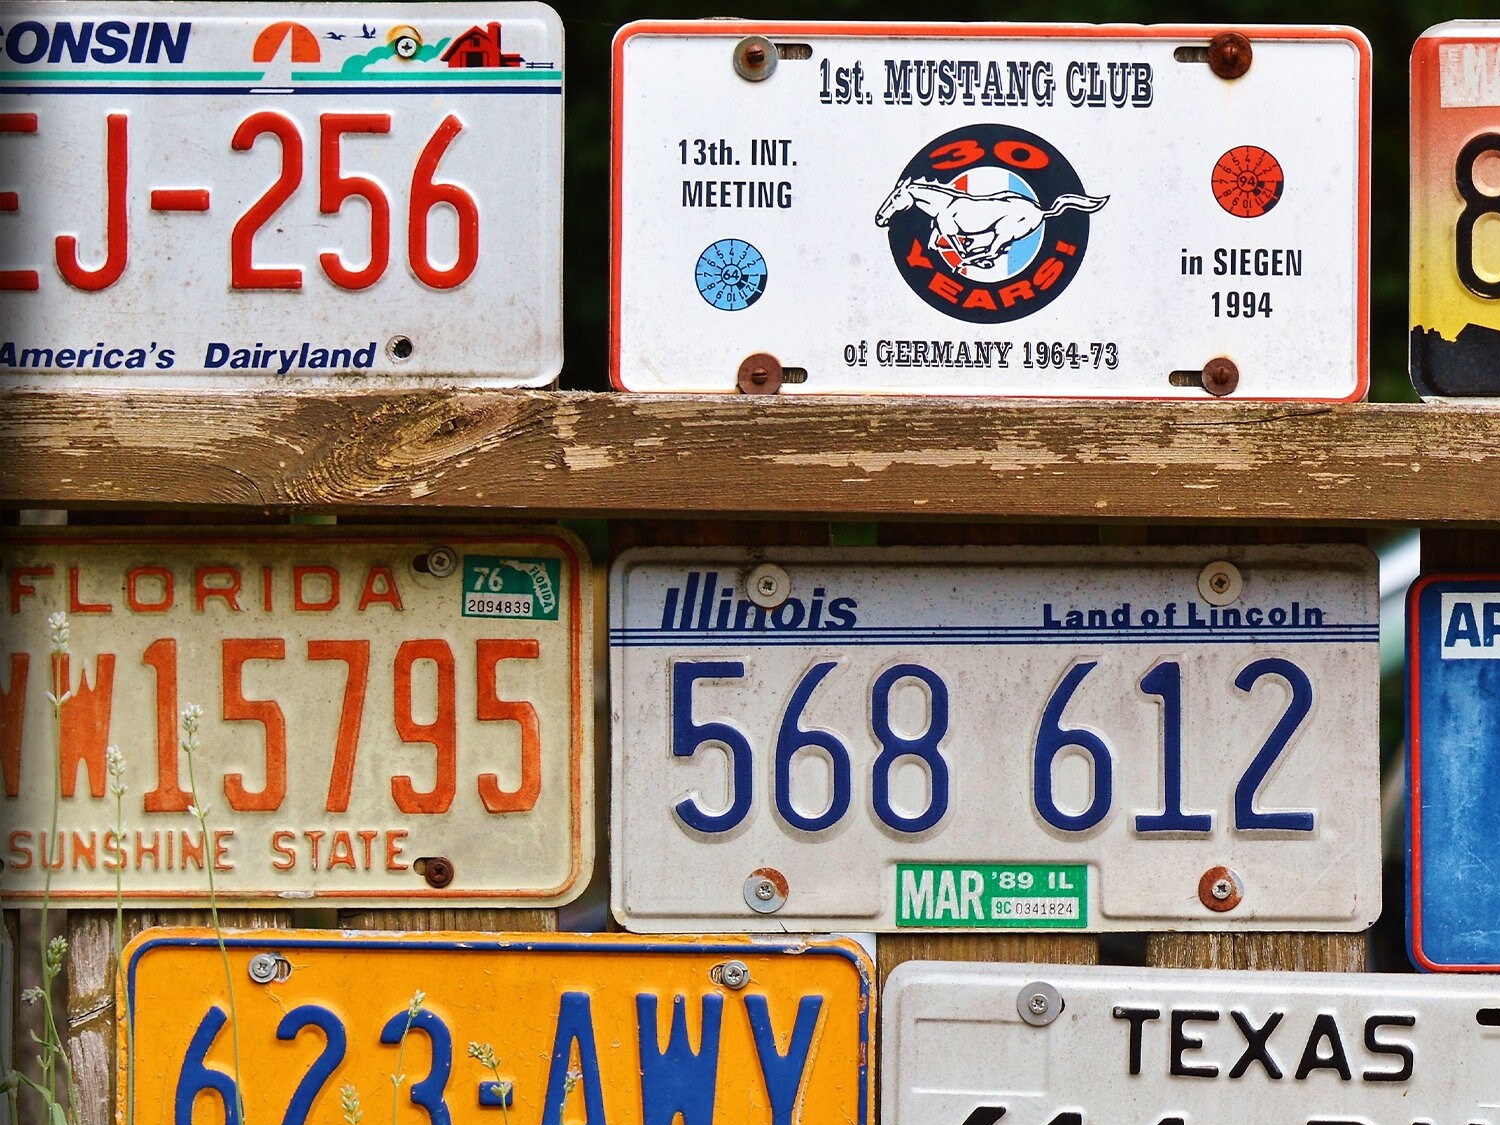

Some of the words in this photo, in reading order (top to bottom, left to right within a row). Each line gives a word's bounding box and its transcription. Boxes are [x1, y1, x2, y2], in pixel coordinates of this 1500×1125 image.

[0, 20, 192, 64] ONSIN
[819, 58, 873, 106] 1st.
[883, 58, 1056, 105] MUSTANG
[1065, 61, 1153, 107] CLUB
[678, 139, 741, 167] 13th.
[750, 140, 798, 167] INT.
[928, 138, 1050, 171] 30
[682, 180, 793, 209] MEETING
[1239, 175, 1256, 187] 94
[722, 269, 740, 281] 64
[905, 237, 1077, 311] YEARS!
[1180, 250, 1202, 276] in
[1214, 248, 1303, 277] SIEGEN
[1211, 290, 1273, 319] 1994
[0, 341, 175, 369] America's
[204, 342, 377, 374] Dairyland
[843, 345, 869, 367] of
[875, 345, 1011, 368] GERMANY
[1022, 345, 1120, 370] 1964-73
[9, 566, 404, 613] FLORIDA
[473, 567, 504, 592] 76
[529, 566, 553, 608] FLORIDA
[468, 600, 531, 613] 2094839
[660, 571, 858, 631] Illinois
[1043, 603, 1131, 628] Land
[1141, 602, 1177, 628] of
[1188, 602, 1325, 627] Lincoln
[673, 660, 949, 833] 568
[1033, 657, 1315, 832] 612
[9, 831, 235, 870] SUNSHINE
[272, 831, 409, 870] STATE
[902, 870, 985, 919] MAR
[1048, 872, 1074, 890] IL
[1112, 1006, 1416, 1081] TEXAS
